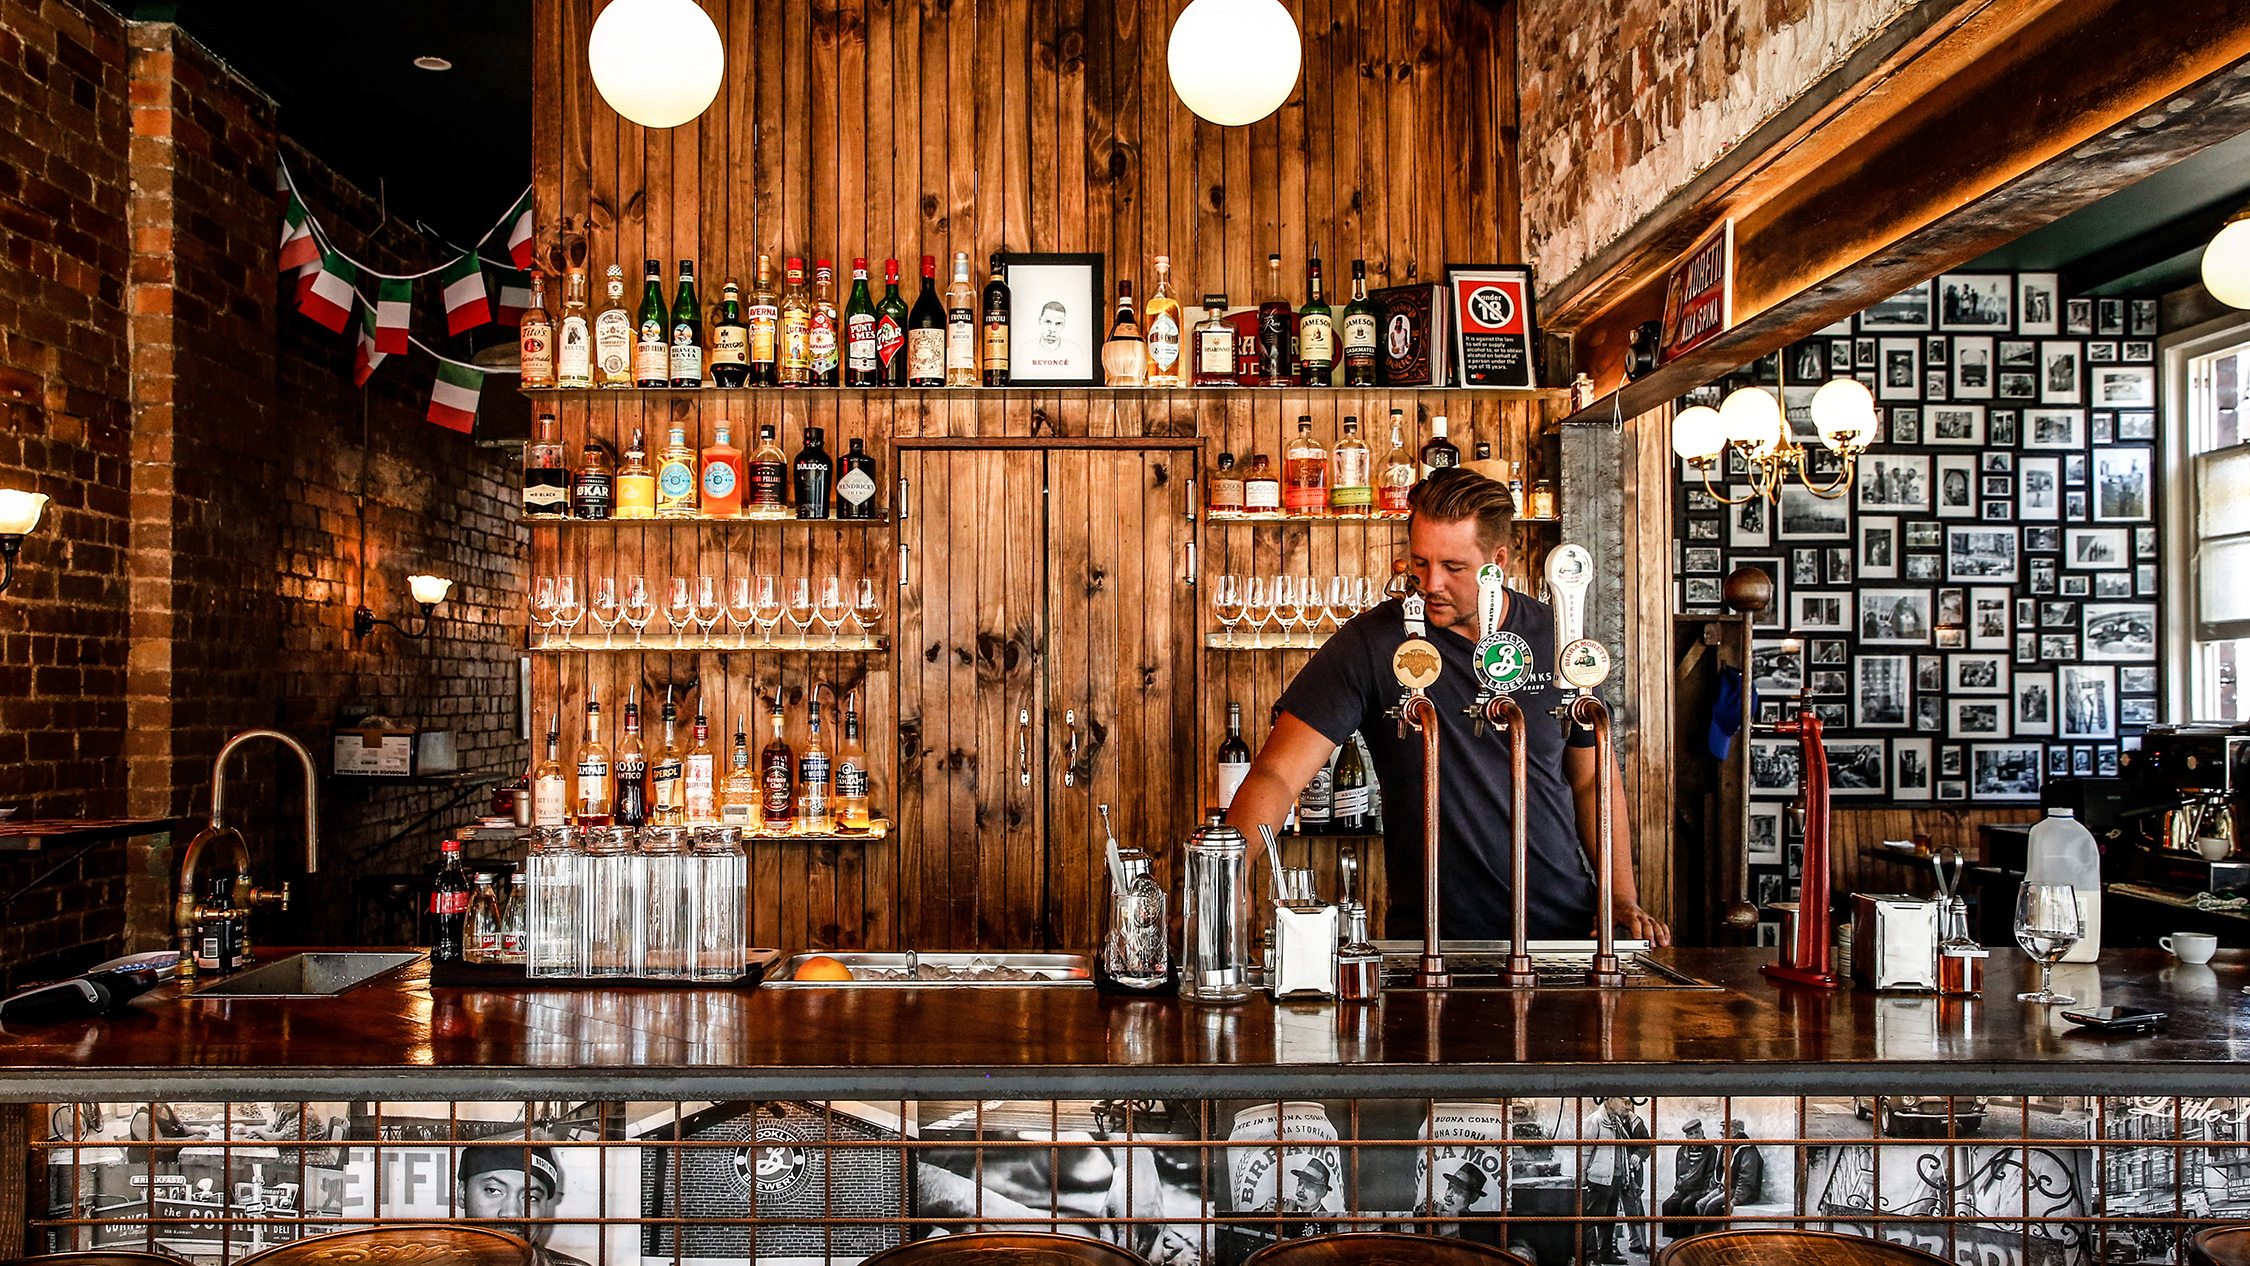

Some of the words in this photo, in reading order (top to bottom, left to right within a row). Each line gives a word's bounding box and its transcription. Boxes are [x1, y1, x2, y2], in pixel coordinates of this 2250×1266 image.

[1684, 237, 1723, 305] MORETTI
[1478, 300, 1503, 321] 18
[1302, 318, 1331, 329] JAMESON
[1345, 318, 1374, 329] JAMESON
[1681, 311, 1696, 344] ALLA
[1697, 297, 1719, 335] SPINA
[850, 323, 873, 333] PUNT
[856, 331, 876, 341] MES
[876, 327, 903, 350] CYNAR
[713, 341, 744, 349] ONTENEGRO
[1032, 358, 1070, 366] BEYONCÉ
[796, 463, 828, 471] BULLDOG
[576, 486, 609, 496] ØKAR
[1409, 605, 1421, 616] 10
[1476, 633, 1527, 656] BROOKLYN
[1564, 643, 1580, 667] BIRRA
[1580, 641, 1608, 663] MORETTI
[1529, 672, 1552, 682] NKS
[1487, 676, 1525, 691] LAGER
[615, 761, 645, 772] ROSSO
[1295, 1125, 1324, 1139] STORIA
[1434, 1128, 1450, 1139] UNA
[1453, 1128, 1486, 1140] STORIA
[743, 1172, 796, 1190] BEWERY
[164, 1207, 182, 1217] the
[273, 1225, 290, 1234] DELI
